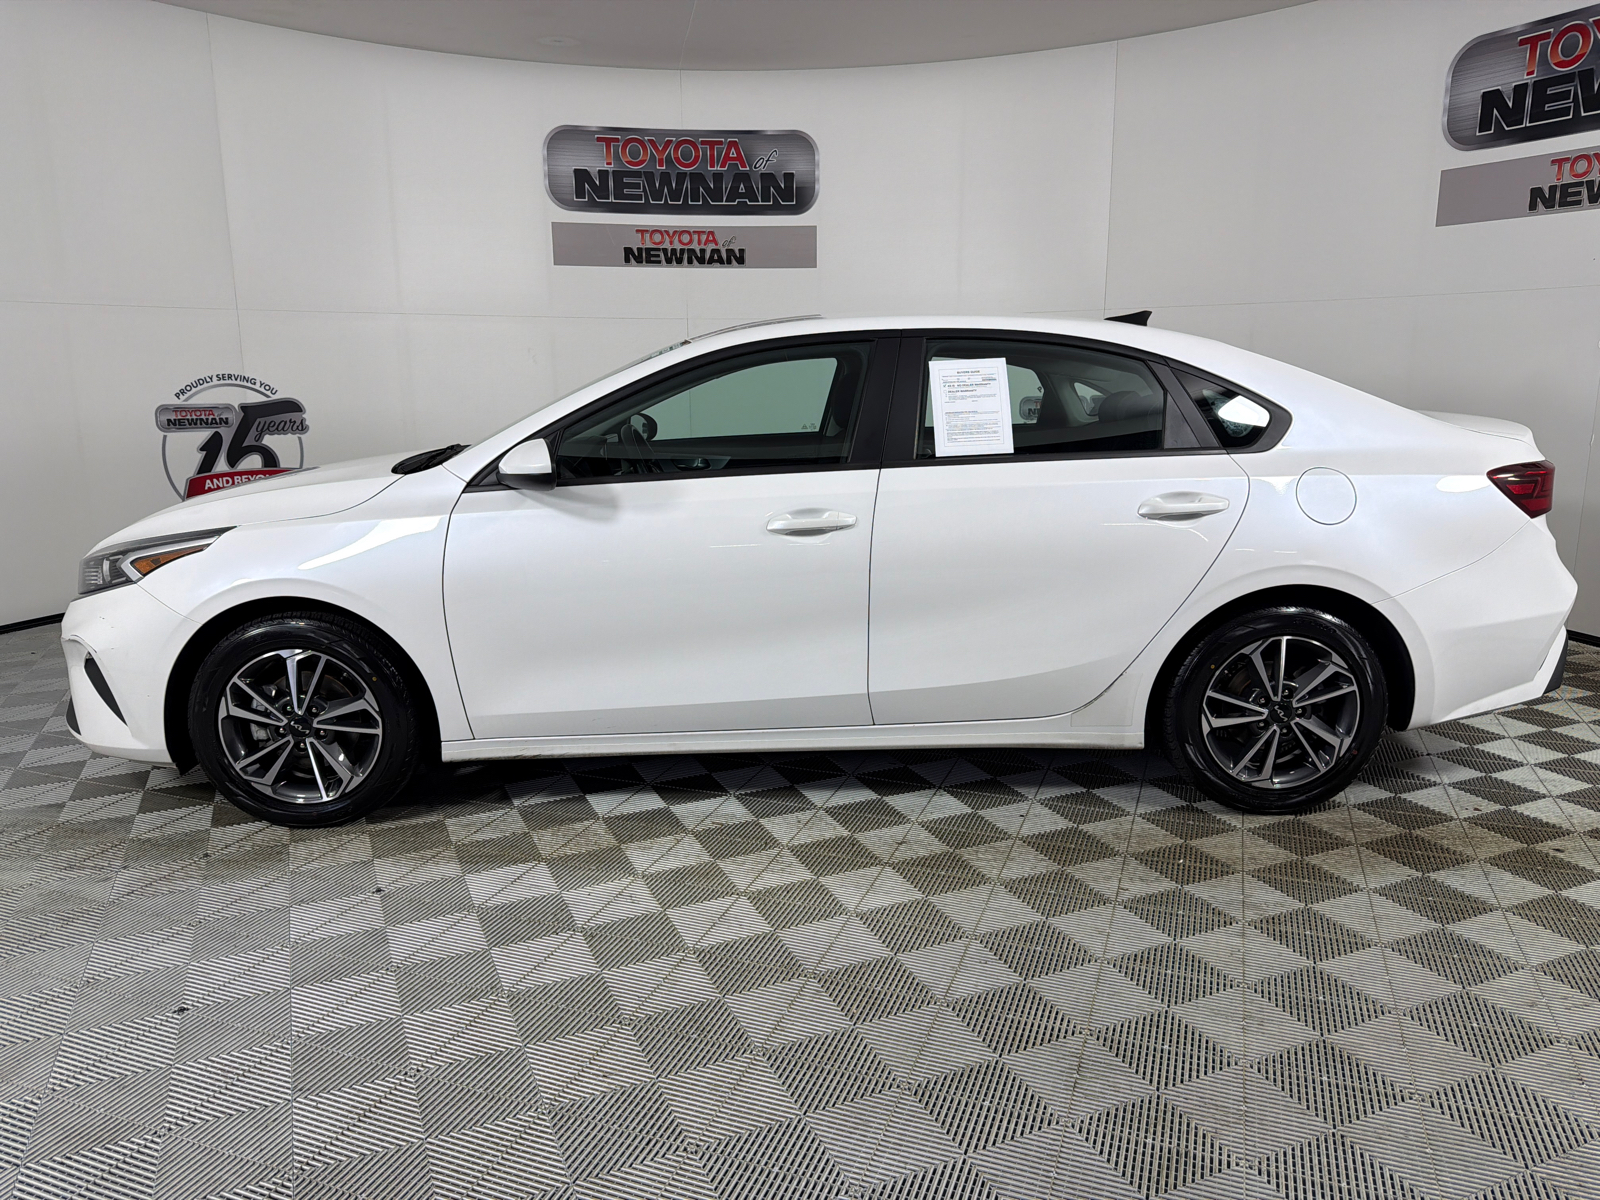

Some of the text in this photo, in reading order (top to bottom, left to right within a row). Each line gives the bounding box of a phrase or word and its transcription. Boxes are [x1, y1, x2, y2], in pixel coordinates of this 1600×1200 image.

[595, 135, 778, 171] TOYOTA of
[572, 168, 796, 204] NEWNAN
[635, 228, 736, 248] TOYOTA of
[623, 246, 746, 266] NEWNAN
[174, 373, 278, 400] PROUDLY SERVING YOU
[166, 416, 229, 427] NEWNAN
[172, 409, 216, 418] TOYOTA
[196, 400, 303, 475] 15
[254, 418, 307, 443] years
[205, 476, 232, 490] AND
